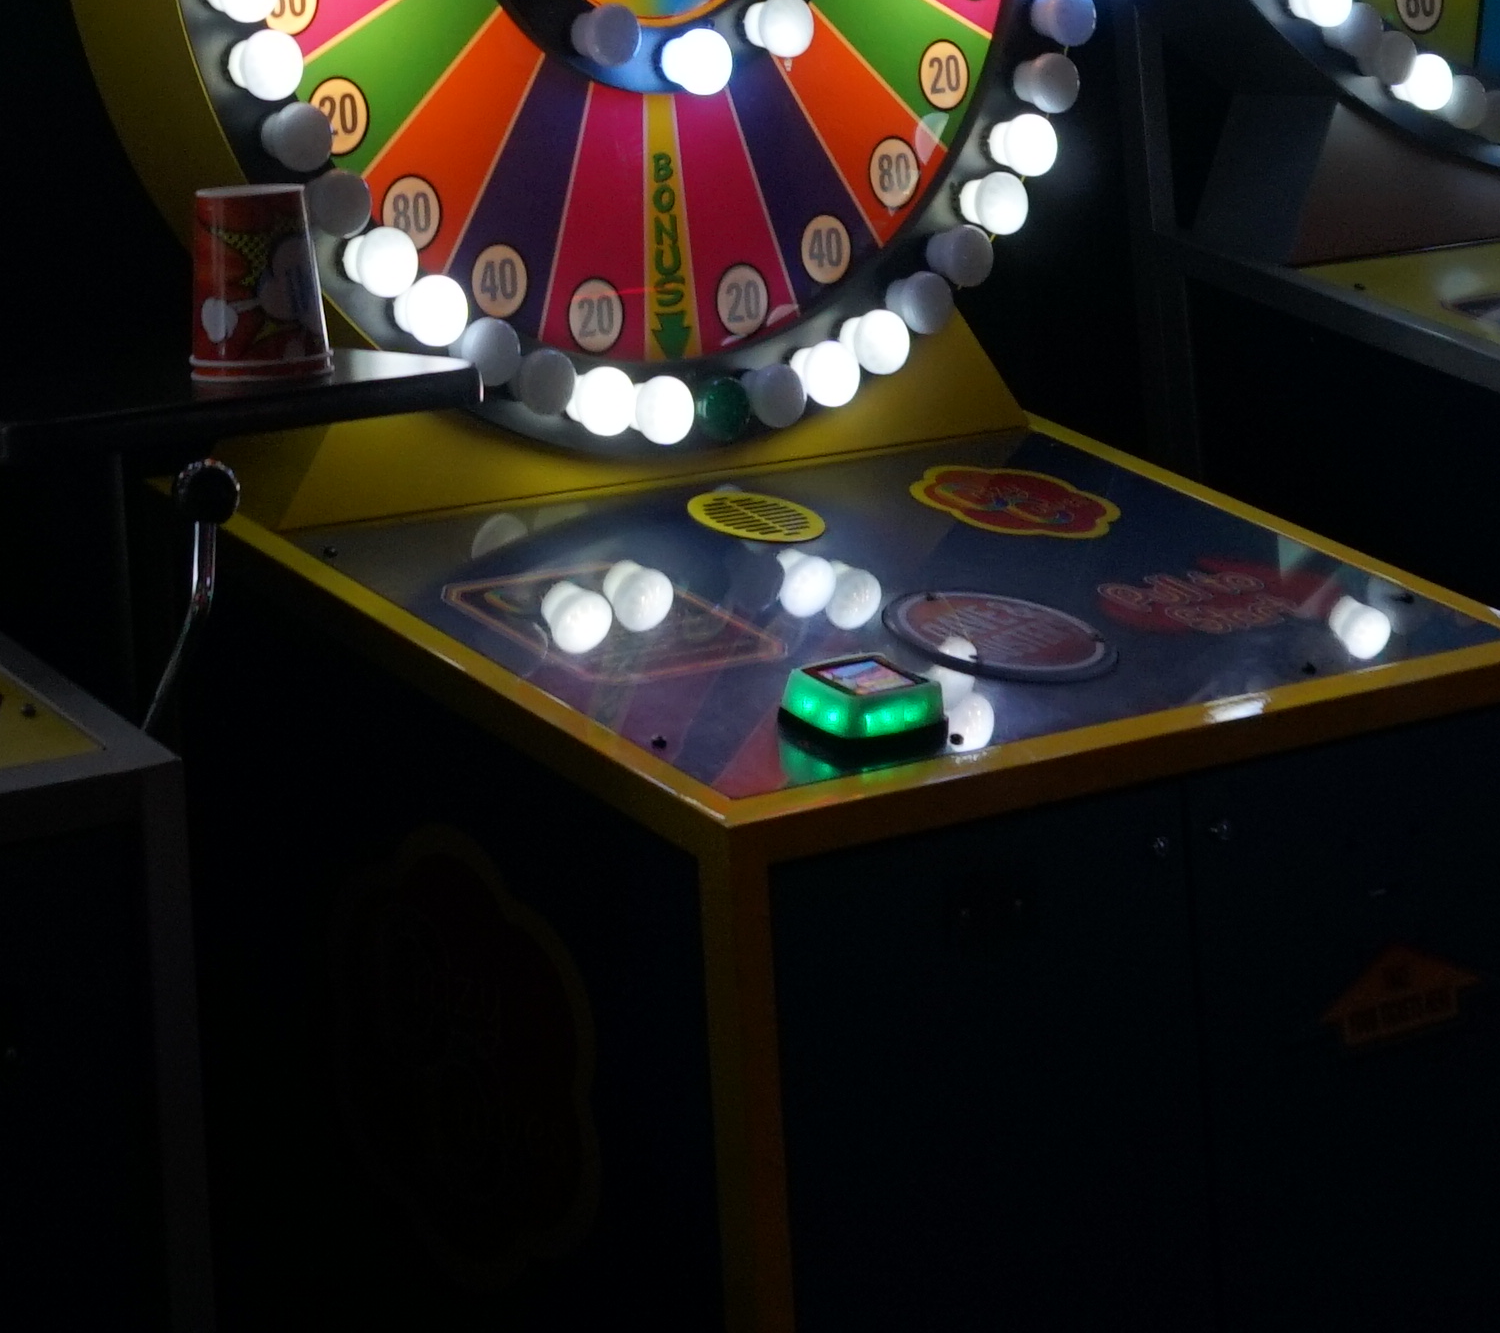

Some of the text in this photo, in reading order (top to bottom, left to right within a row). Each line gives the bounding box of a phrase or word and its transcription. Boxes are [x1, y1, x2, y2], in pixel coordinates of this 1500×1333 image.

[930, 56, 960, 94] 20
[878, 153, 910, 189] 80
[392, 194, 432, 233] 80
[652, 154, 684, 307] BONUS
[809, 230, 842, 267] 40
[481, 259, 518, 300] 40
[578, 296, 615, 337] 20
[726, 280, 760, 321] 20
